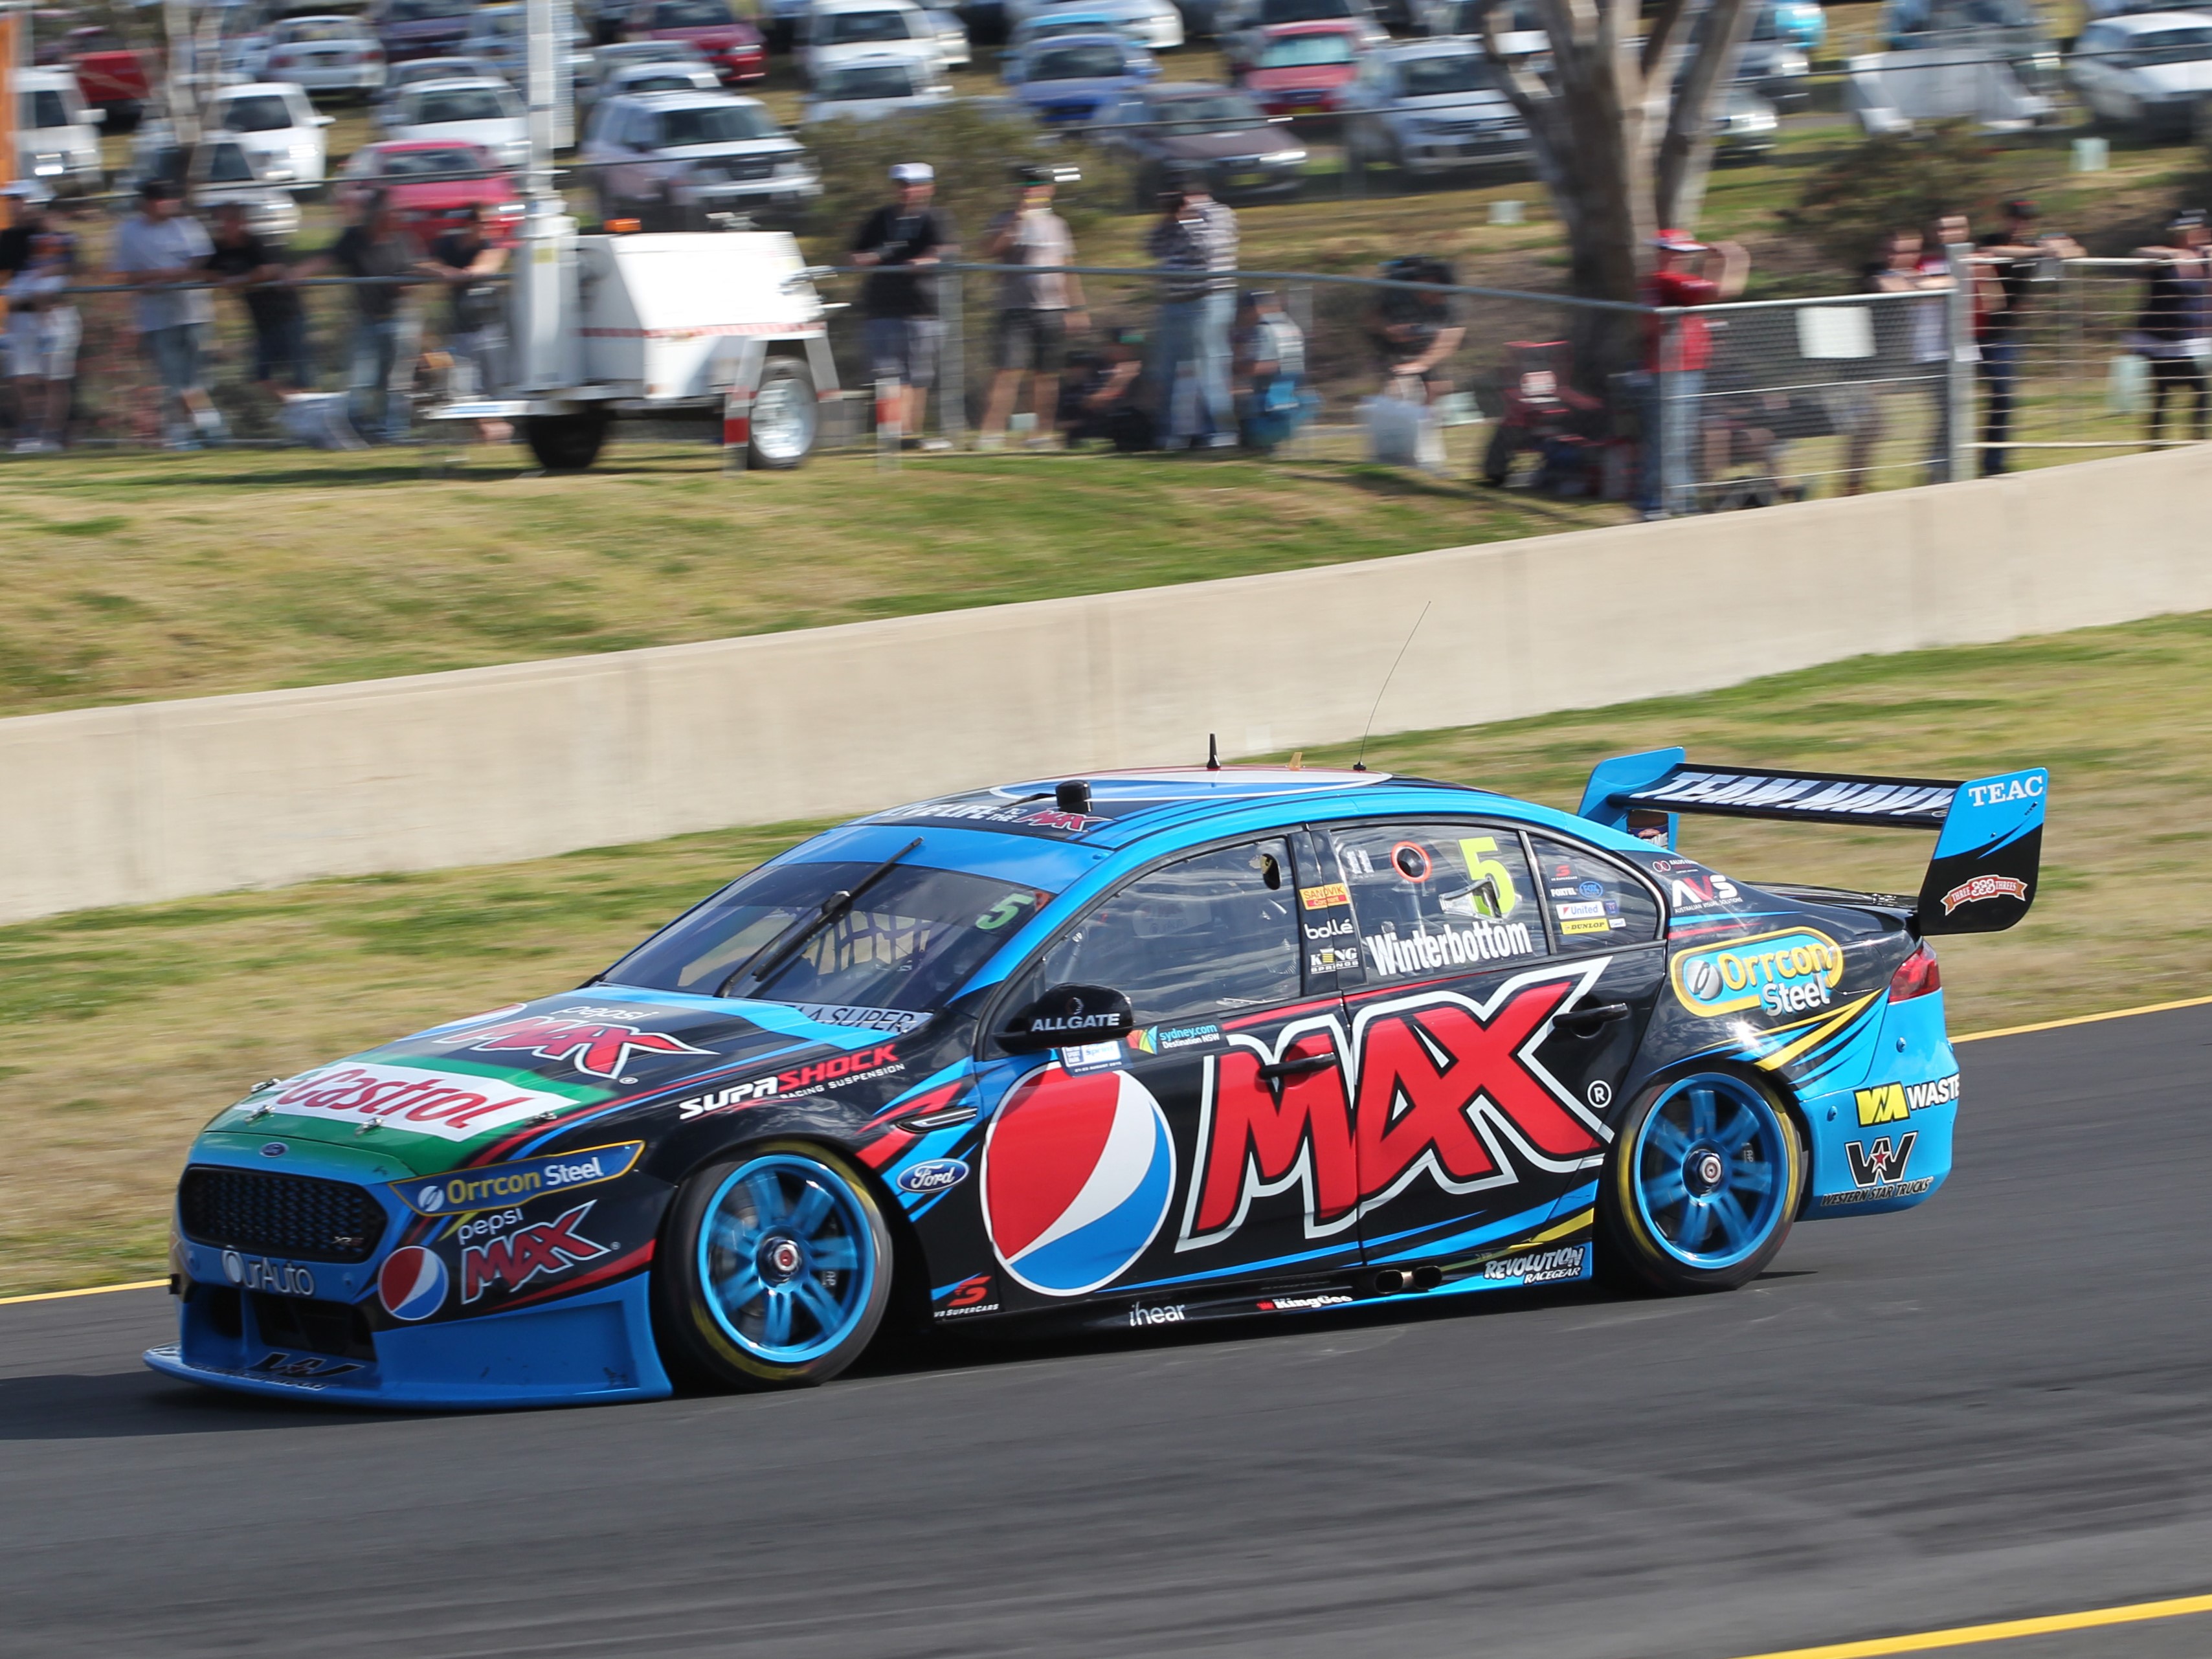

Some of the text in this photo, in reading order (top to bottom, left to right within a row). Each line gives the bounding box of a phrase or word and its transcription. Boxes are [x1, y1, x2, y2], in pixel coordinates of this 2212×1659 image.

[1629, 772, 1821, 807] TEAM
[1968, 775, 2044, 807] TEAC
[1011, 809, 1113, 832] MAX
[1302, 885, 1345, 900] SANDVIK
[1458, 836, 1516, 918] 5
[1550, 887, 1577, 897] FOXTEL
[1672, 874, 1737, 907] AVS
[1951, 886, 1971, 902] THREE
[1995, 880, 2016, 891] THREES
[975, 893, 1035, 930] 5
[1571, 904, 1598, 915] United
[1675, 904, 1703, 914] AUSTRALIAN
[1304, 918, 1354, 939] bollé
[1571, 922, 1605, 930] DUNLOP
[1365, 920, 1533, 976] Winterbottom
[1717, 942, 1833, 991] Orrcon
[1761, 969, 1831, 1016] Steel
[551, 1005, 658, 1021] pepsi
[1031, 1013, 1121, 1032] ALLGATE
[432, 1016, 720, 1079] MAX
[1159, 1024, 1218, 1041] sydney.com
[1162, 1033, 1220, 1049] Destination NSW
[678, 1043, 900, 1120] SUPASHOCK
[779, 1063, 906, 1099] RACING SUSPENSION
[276, 1069, 533, 1129] Castrol
[1174, 956, 1614, 1253] MAX
[447, 1157, 603, 1204] Orrcon Steel
[910, 1163, 956, 1189] Ford
[1821, 1178, 1930, 1207] WESTERN STAR TRUCKS
[457, 1208, 524, 1245] pepsi
[461, 1199, 612, 1306] MAX
[1484, 1247, 1584, 1280] REVOLUTION
[222, 1245, 315, 1296] OurAuto
[1524, 1267, 1581, 1284] RACEGEAR
[1129, 1301, 1186, 1327] ihear
[1273, 1295, 1353, 1309] KingGee
